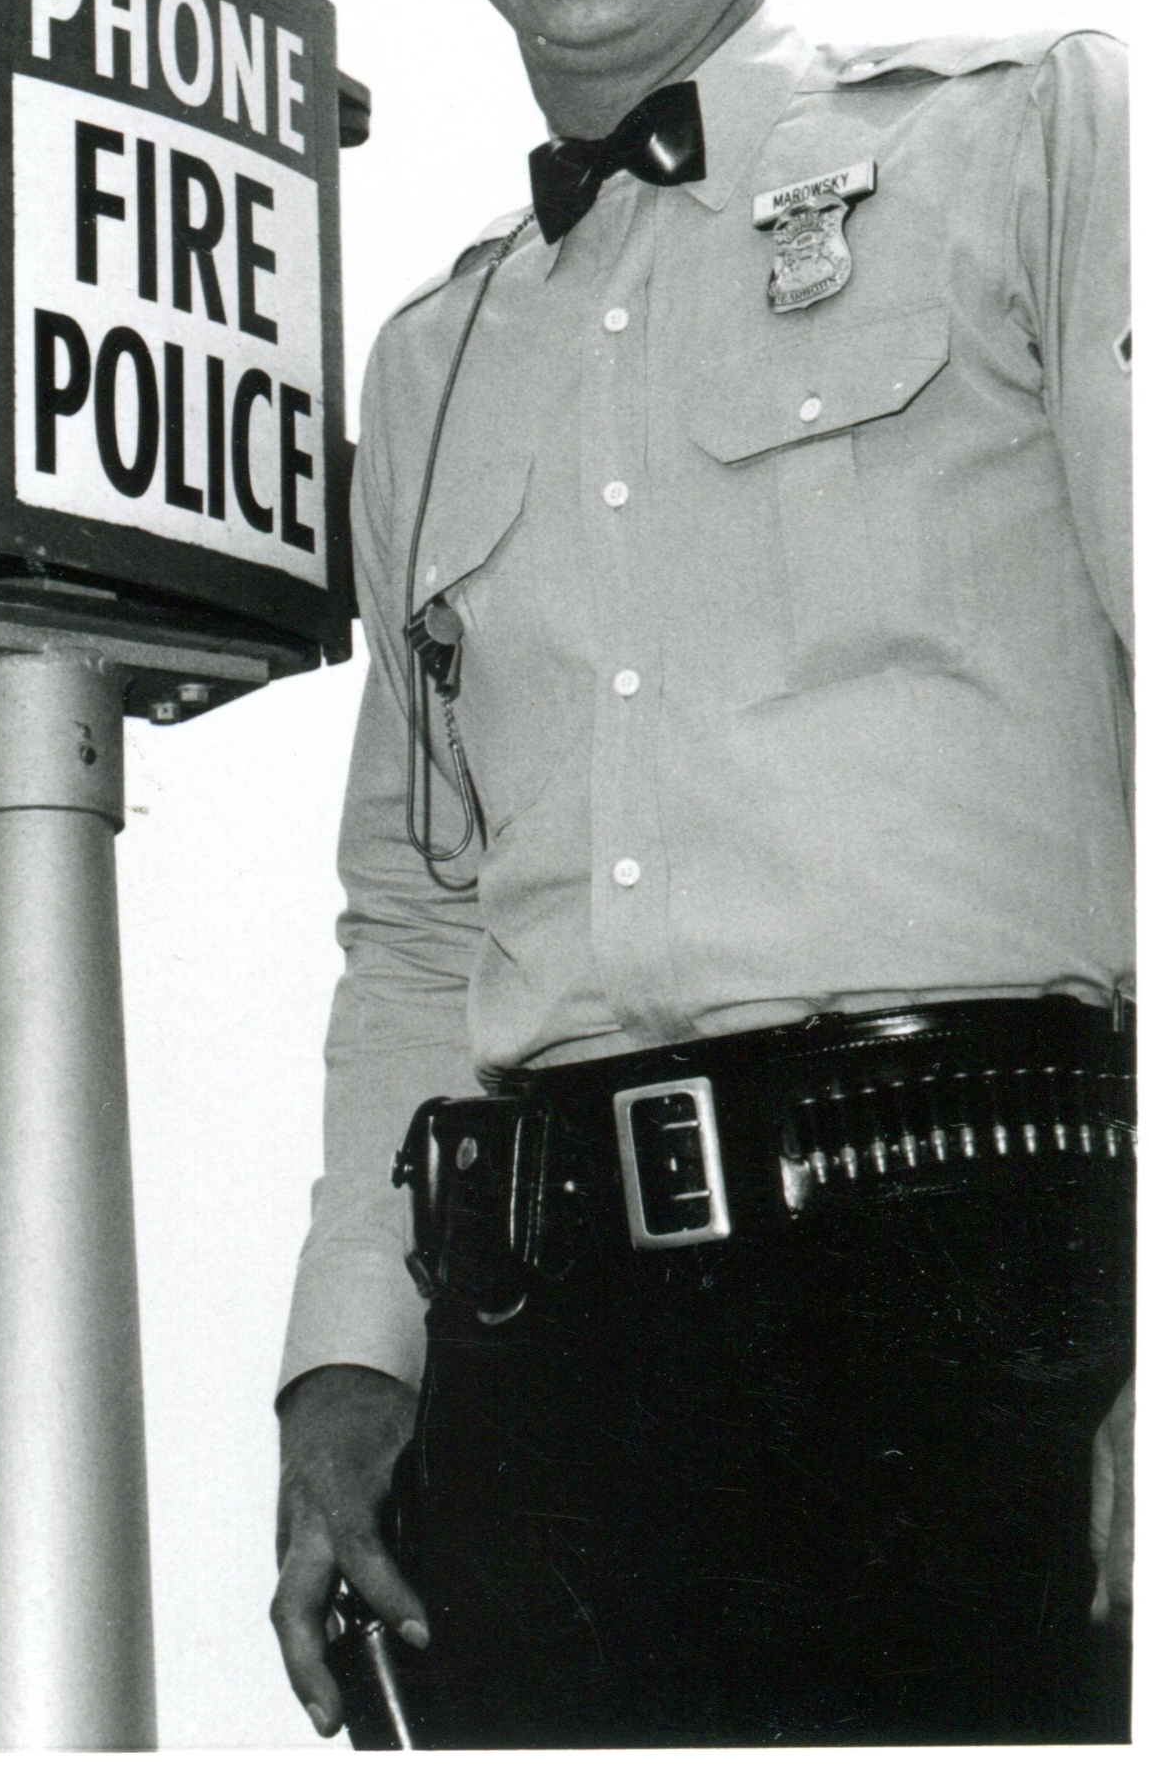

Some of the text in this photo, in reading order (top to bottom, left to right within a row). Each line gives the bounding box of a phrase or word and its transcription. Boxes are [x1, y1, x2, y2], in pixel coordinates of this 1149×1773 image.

[75, 119, 278, 345] FIRE
[773, 173, 850, 209] MAROWSKY
[34, 308, 316, 553] POLICE
